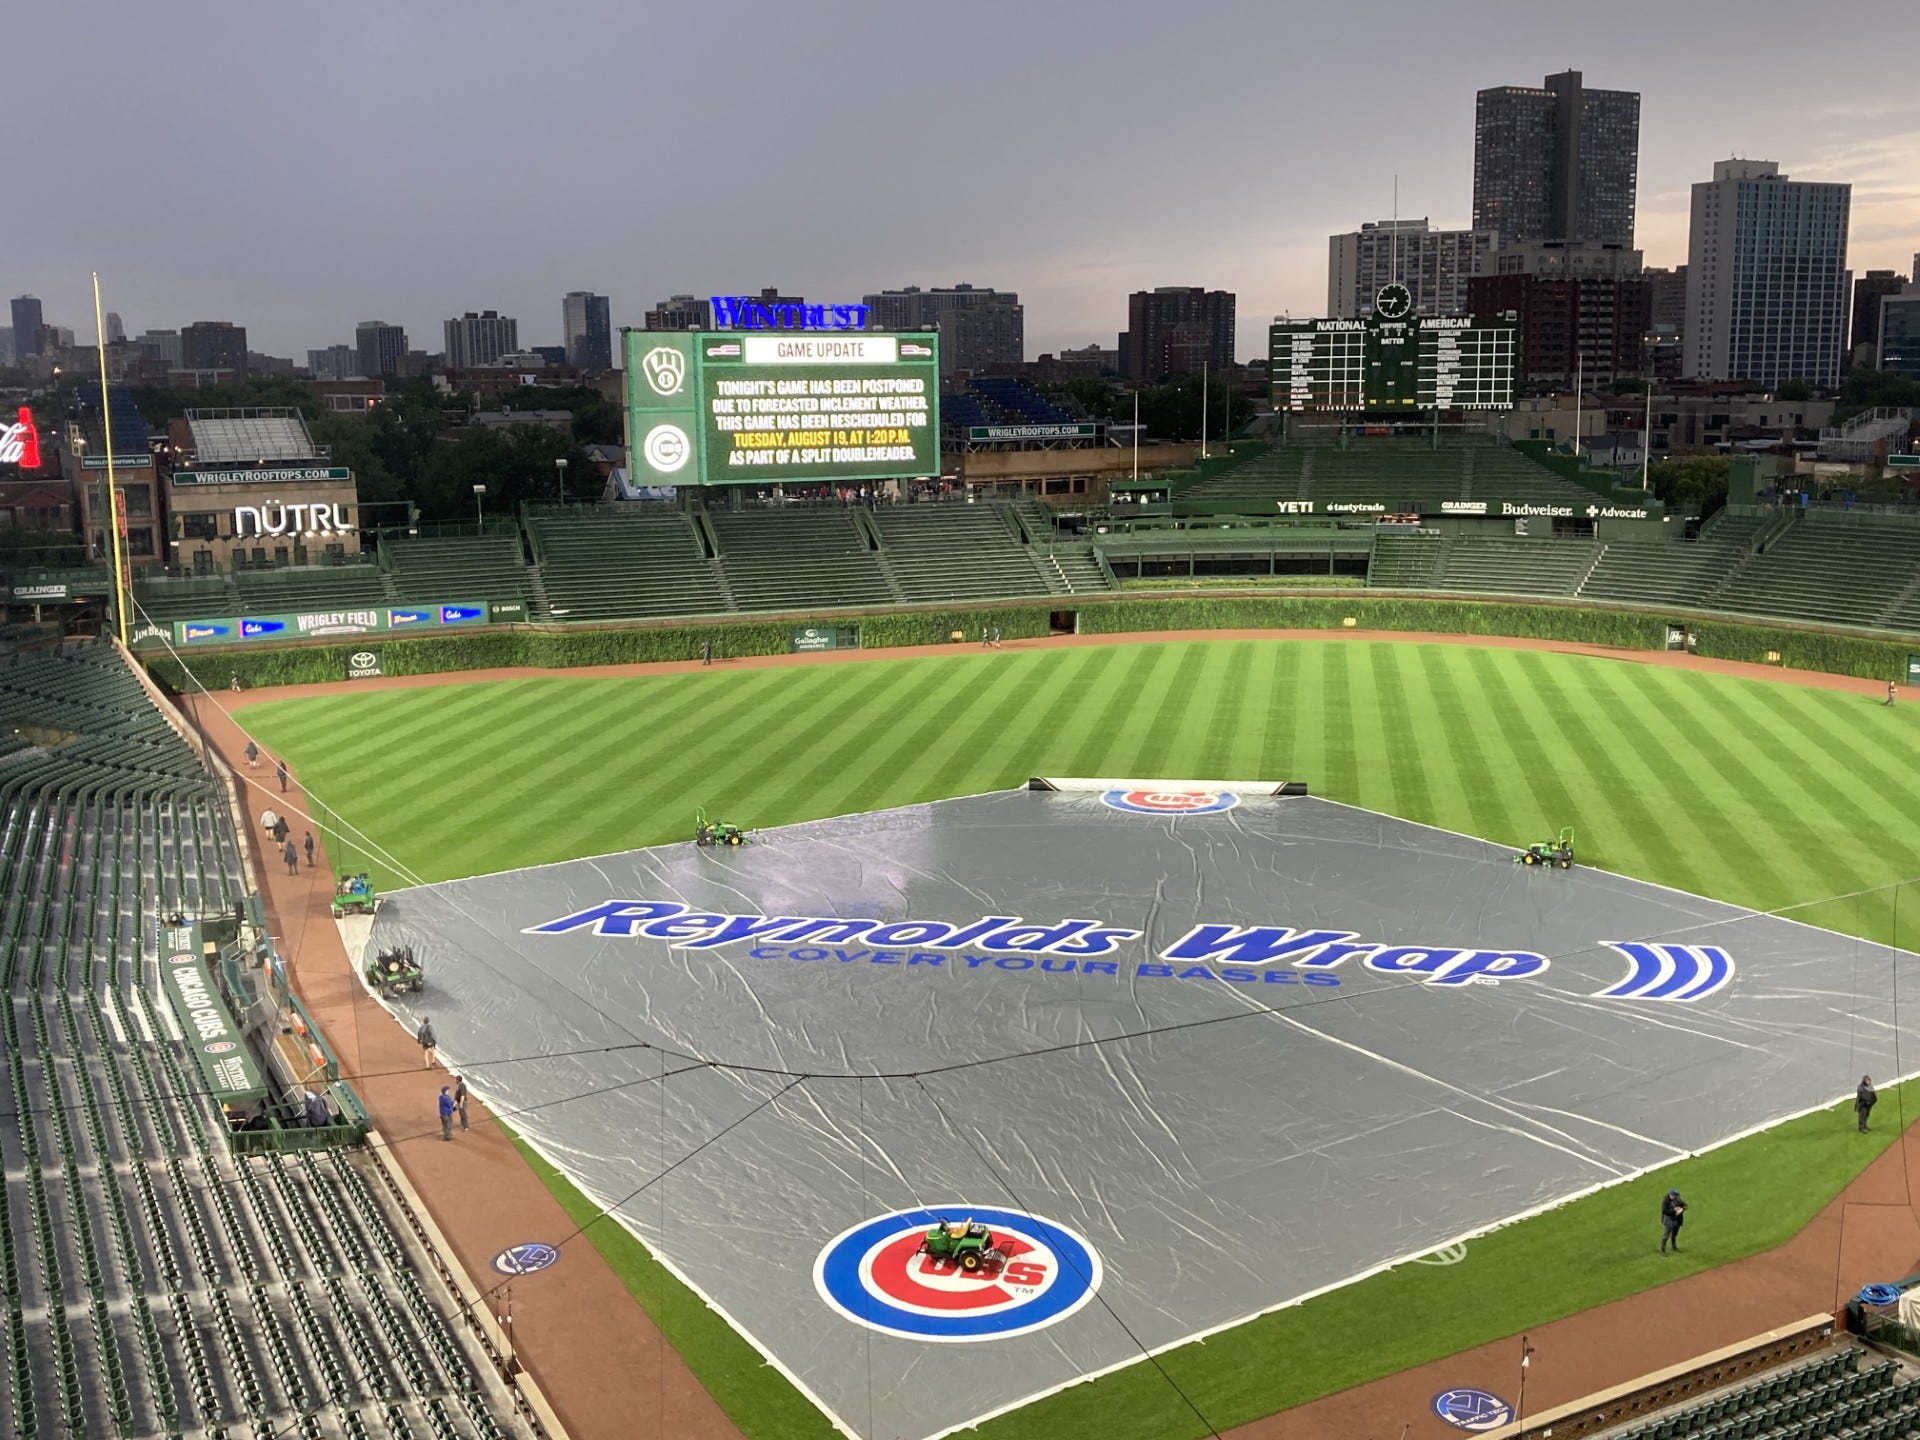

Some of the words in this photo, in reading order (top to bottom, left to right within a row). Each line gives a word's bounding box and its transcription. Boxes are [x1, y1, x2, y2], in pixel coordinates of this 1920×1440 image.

[710, 296, 871, 330] WINTRUST
[1317, 320, 1367, 331] NATIONAL
[1420, 318, 1471, 328] AMERICAN
[778, 342, 813, 357] GAME
[817, 342, 864, 357] UPDATE
[717, 380, 776, 395] TONIGHT'S
[777, 380, 808, 395] GAME
[810, 380, 832, 394] HAS
[833, 379, 861, 394] BEEN
[862, 379, 924, 393] POSTPONED
[712, 399, 735, 413] DUE
[736, 399, 751, 413] TO
[752, 398, 819, 412] FORECASTED
[820, 397, 878, 411] INCLEMENT
[879, 396, 928, 410] WEATHER.
[716, 416, 743, 430] THIS
[744, 415, 776, 430] GAME
[777, 415, 800, 429] HAS
[801, 414, 829, 429] BEEN
[830, 413, 904, 428] RESCHEDULED
[906, 412, 927, 426] FOR
[733, 432, 786, 447] TUESDAY,
[788, 431, 831, 446] AUGUST
[834, 431, 848, 445] 19,
[849, 430, 864, 444] AT
[866, 430, 887, 444] 1:20
[888, 429, 911, 443] P.M.
[988, 426, 1079, 437] WRIGLEYROOFTOPS.COM
[729, 451, 745, 465] AS
[746, 450, 775, 465] PART
[776, 449, 790, 464] OF
[791, 449, 800, 464] A
[801, 448, 831, 463] SPLIT
[832, 446, 916, 462] DOUBLEHEADER.
[195, 470, 330, 483] WRIGLEYROOFTOPS.COM
[1277, 501, 1314, 512] YETI
[1334, 503, 1385, 513] tastytrade
[1600, 507, 1648, 518] Advocate
[13, 585, 66, 595] GRAINGER
[297, 614, 343, 631] WRIGLEY
[347, 611, 377, 626] FIELD
[445, 610, 461, 619] Cubs
[133, 629, 148, 643] JIM
[148, 626, 171, 641] BEAM
[245, 624, 262, 633] Cubs
[348, 668, 382, 677] TOYOTA
[521, 900, 1144, 955] Reynolds
[1159, 924, 1551, 987] Wrap
[750, 947, 946, 966] COVER
[962, 955, 1117, 974] YOUR
[1136, 963, 1341, 987] BASES
[172, 966, 213, 1009] CHICAGO
[190, 1007, 227, 1041] CUBS
[1014, 1286, 1034, 1294] TM
[1455, 1414, 1488, 1426] TRAFFIC
[1488, 1406, 1509, 1415] TECH
